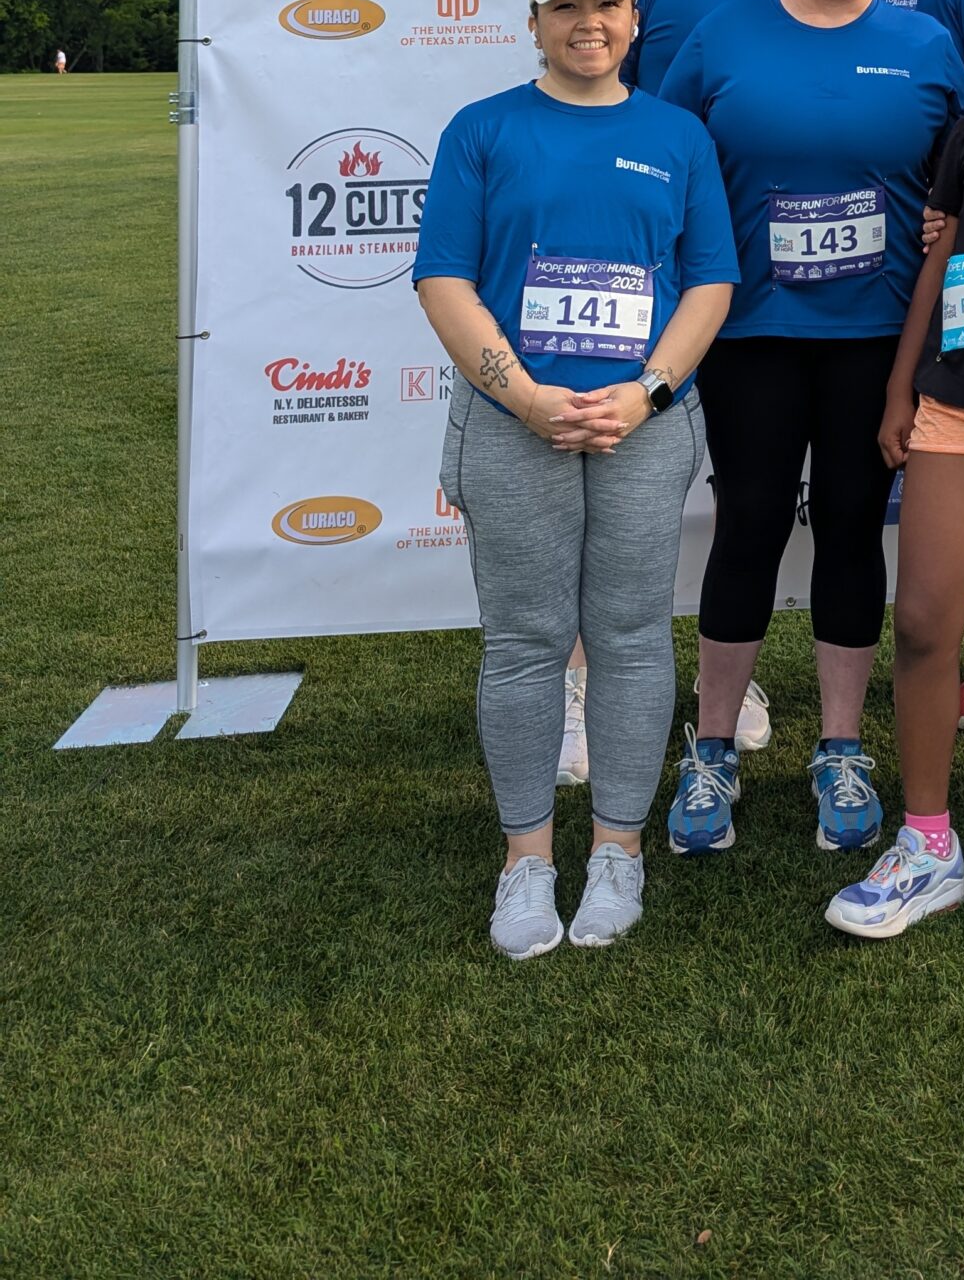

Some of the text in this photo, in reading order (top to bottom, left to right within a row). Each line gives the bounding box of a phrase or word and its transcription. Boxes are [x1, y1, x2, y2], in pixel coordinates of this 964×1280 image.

[307, 8, 361, 25] LURACO
[411, 24, 502, 35] THE UNIVERSITY
[400, 35, 517, 46] OF TEXAS AT DALLAS
[615, 157, 650, 174] BUTLER
[776, 190, 876, 210] HOPE RUN FOR HUNGER
[846, 200, 877, 216] 2025
[285, 183, 428, 238] 12 CUTS
[800, 224, 858, 256] 143
[290, 241, 419, 257] BRAZILIAN STEAKHOU
[536, 261, 646, 278] HOPE RUN FOR HUNGER
[611, 275, 645, 291] 2025
[556, 294, 620, 329] 141
[264, 357, 372, 392] Cindi's
[274, 395, 369, 411] N.Y. DELICATESSEN
[272, 410, 369, 425] RESTAURANT & BAKERY
[301, 510, 356, 530] LURACO
[408, 525, 468, 537] THE UNIVE
[396, 536, 469, 549] OF TEXAS AT
